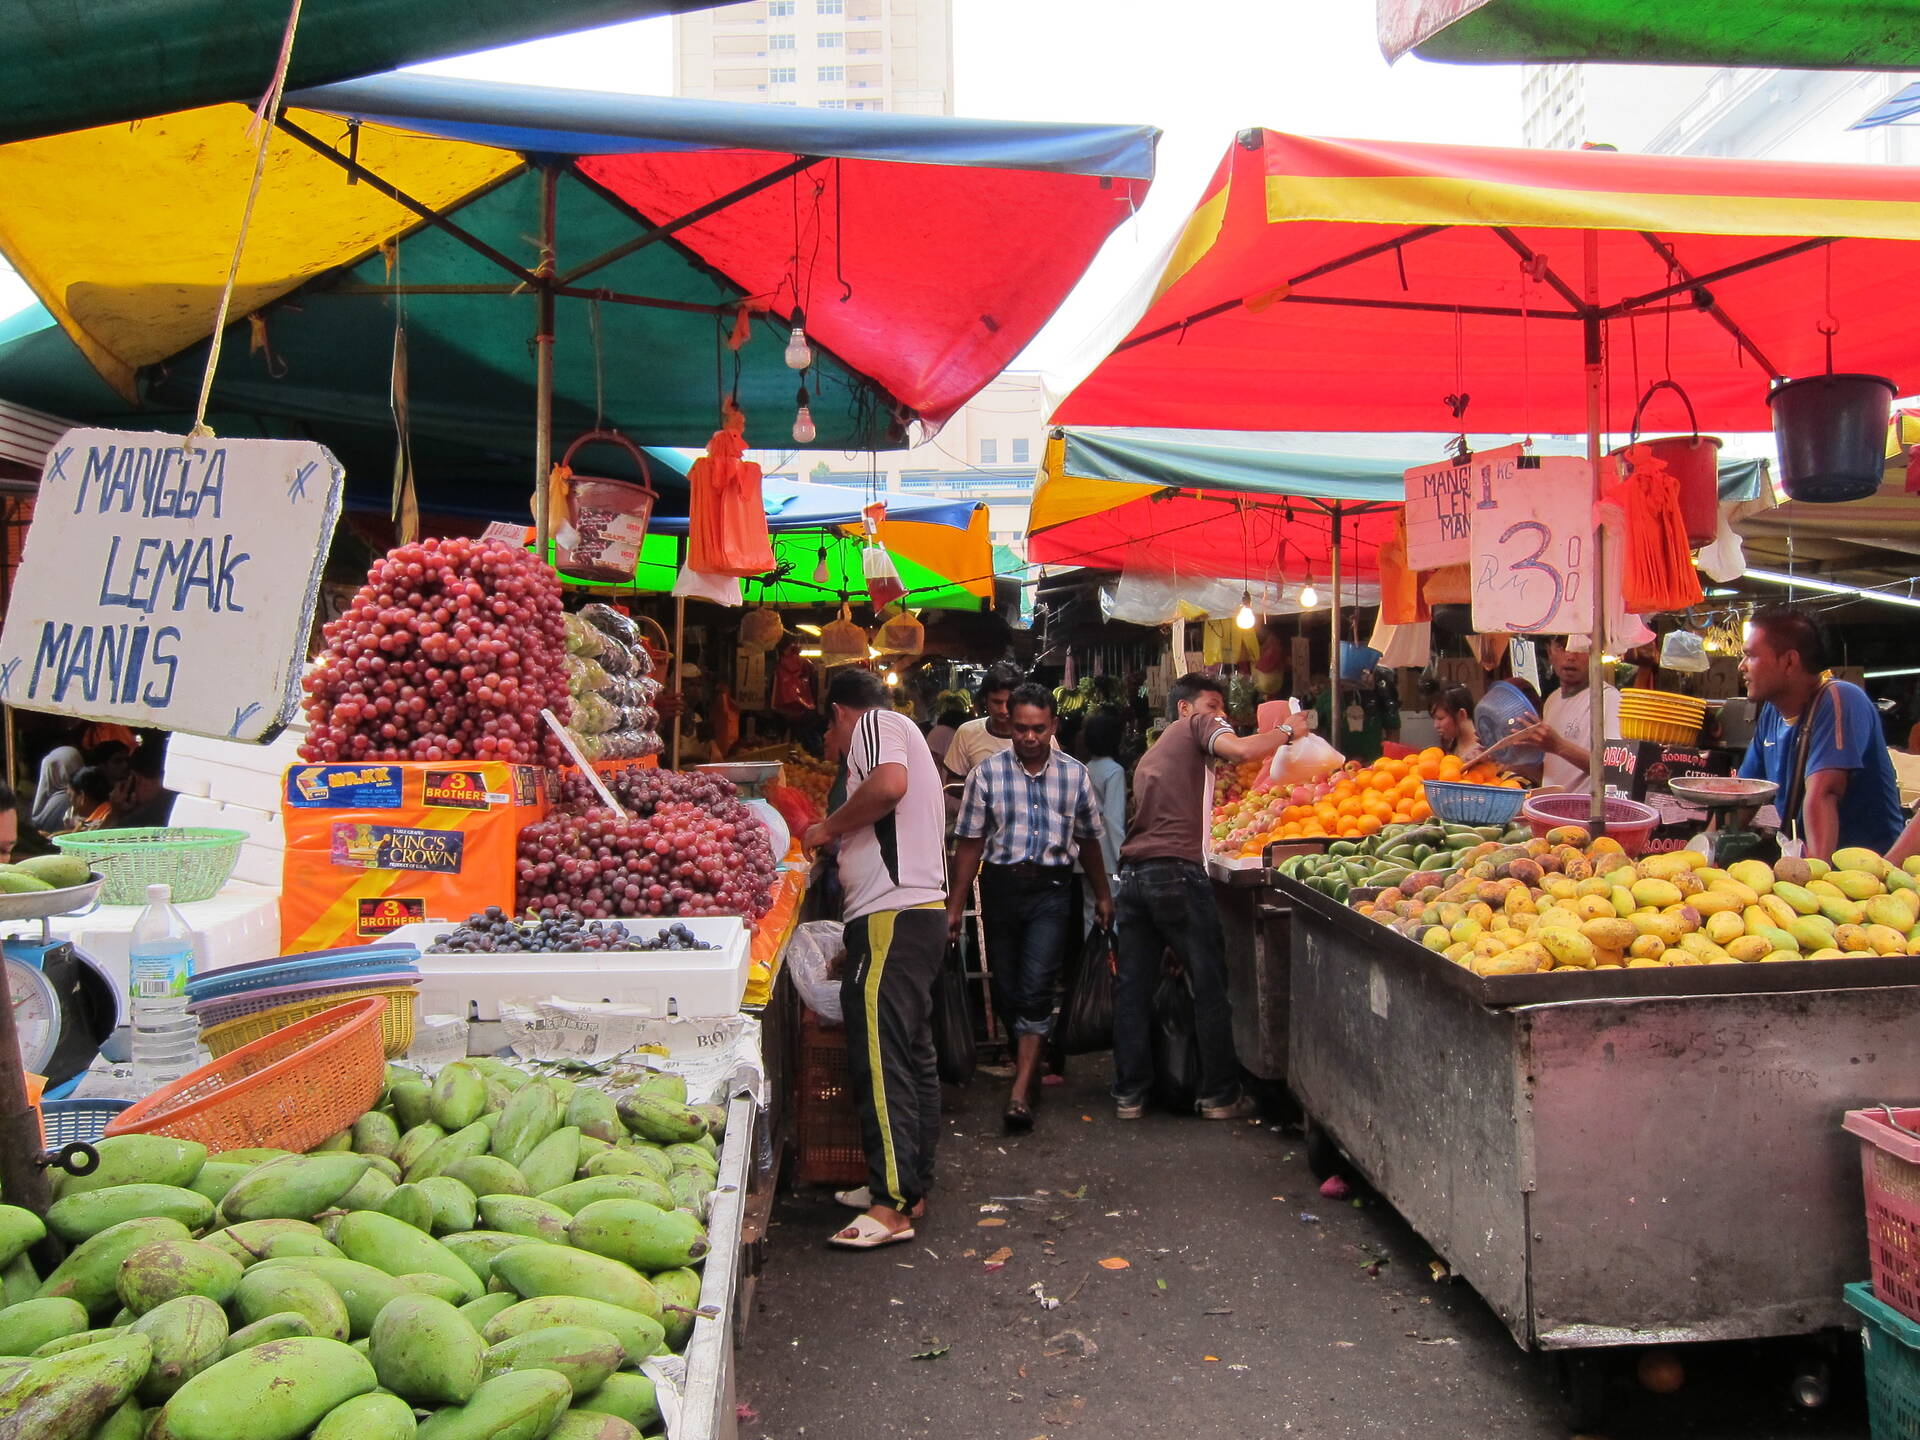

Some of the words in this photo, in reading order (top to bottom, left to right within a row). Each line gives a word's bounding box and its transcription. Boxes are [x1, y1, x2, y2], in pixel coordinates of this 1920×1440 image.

[74, 446, 226, 518] MANGGA
[99, 534, 250, 613] LEMAK
[1498, 520, 1563, 632] 3
[27, 615, 181, 708] MANIS
[449, 773, 467, 790] 3
[389, 848, 458, 867] CROWN
[391, 834, 447, 851] KING'S
[383, 900, 400, 917] 3
